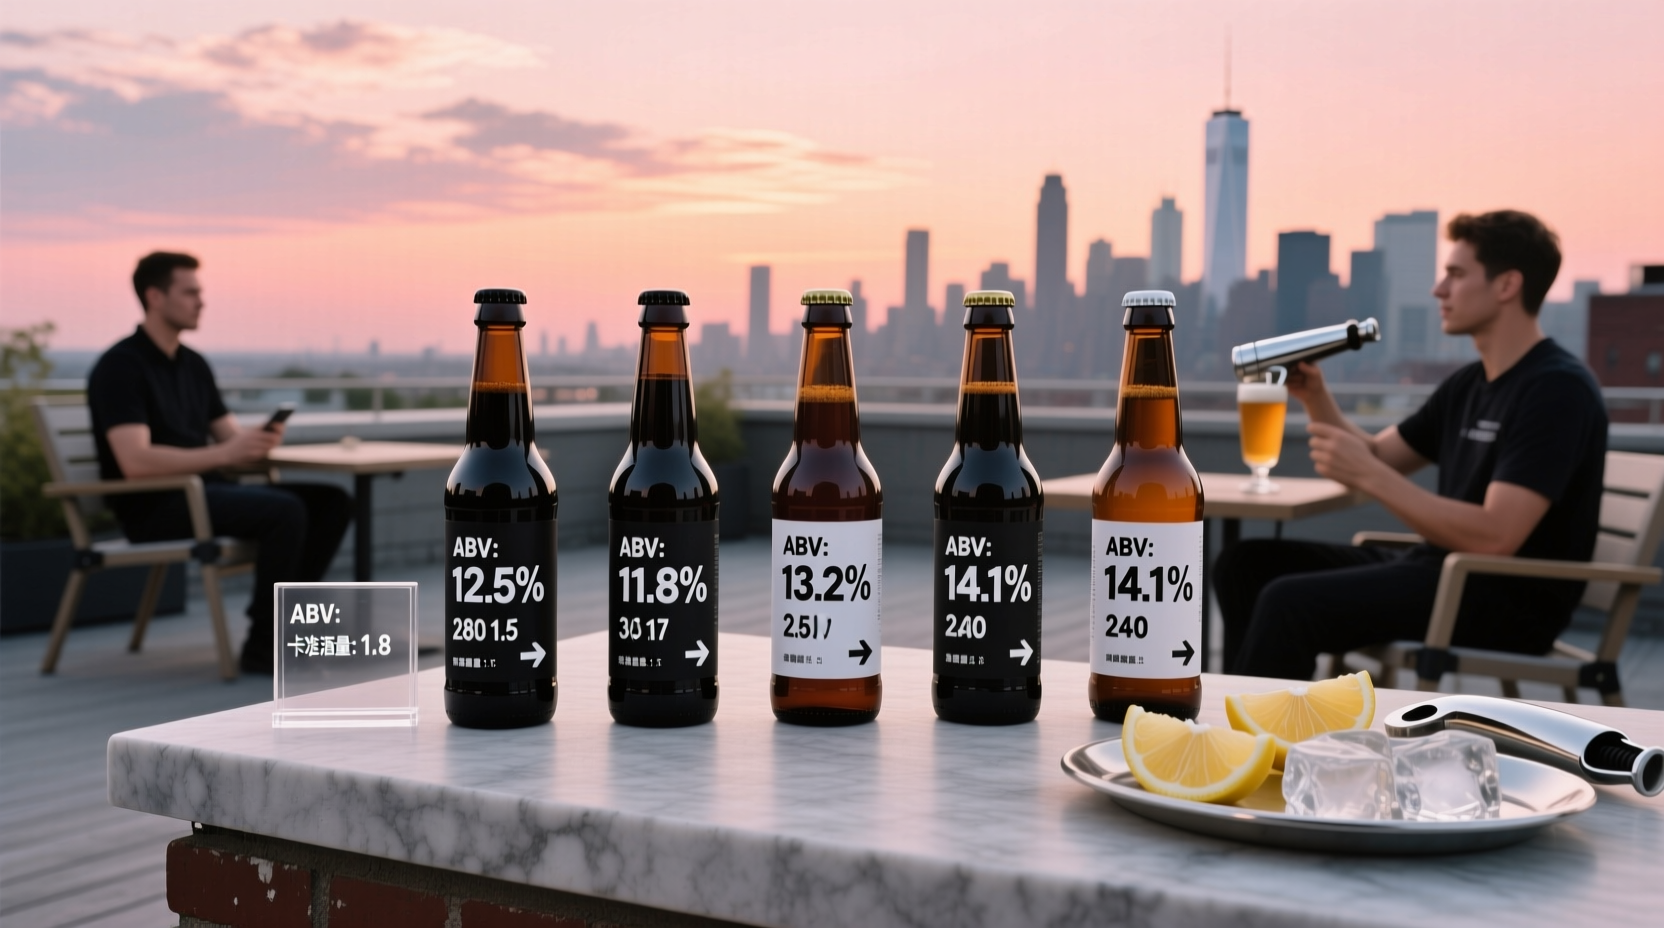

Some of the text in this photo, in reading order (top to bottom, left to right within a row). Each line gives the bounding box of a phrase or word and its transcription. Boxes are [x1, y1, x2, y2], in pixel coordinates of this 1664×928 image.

[453, 536, 499, 558] ABV:
[619, 536, 665, 558] ABV:
[783, 535, 829, 557] ABV:
[945, 535, 992, 557] ABV:
[1105, 536, 1154, 557] ABV:
[452, 565, 545, 604] 12.5%
[618, 565, 708, 604] 11.8%
[782, 563, 871, 602] 13.2%
[944, 563, 1032, 603] 14.1%
[1104, 565, 1193, 603] 14.1%
[290, 603, 341, 624] ABV:
[452, 617, 518, 641] 280 1.5
[1105, 613, 1148, 639] 240
[360, 634, 391, 656] 1.8
